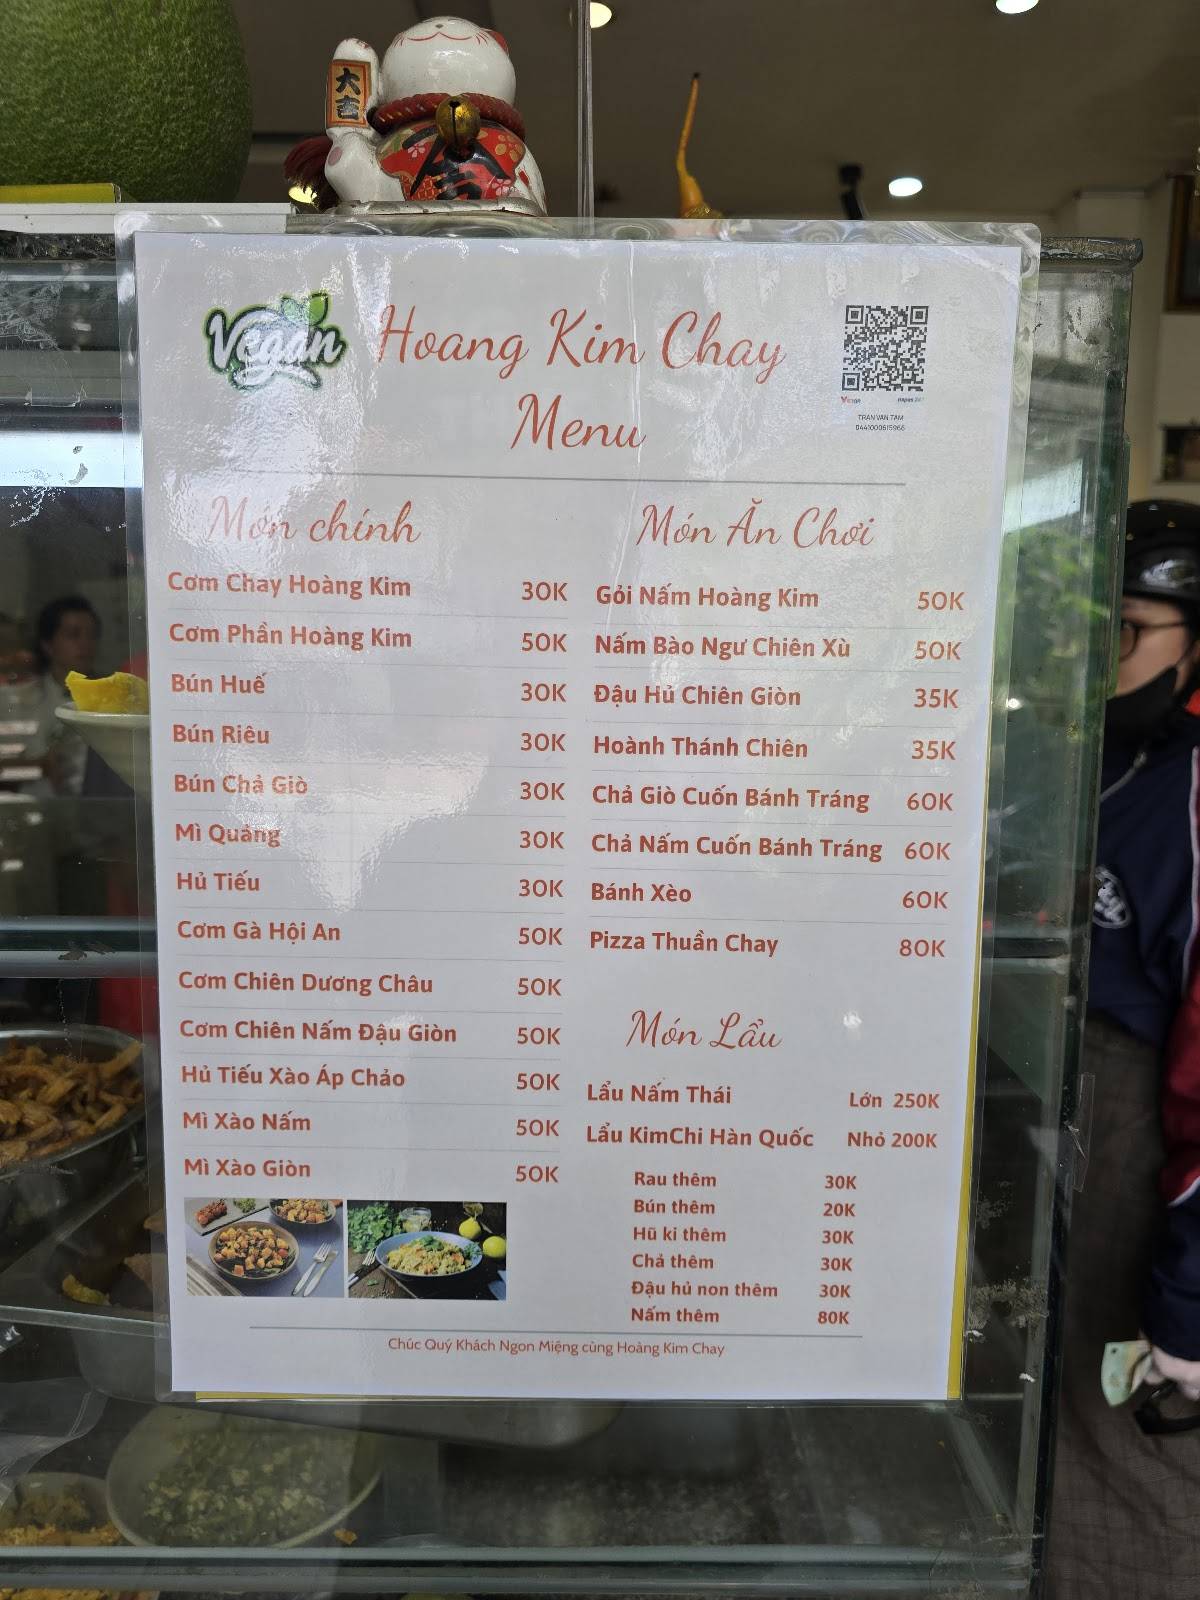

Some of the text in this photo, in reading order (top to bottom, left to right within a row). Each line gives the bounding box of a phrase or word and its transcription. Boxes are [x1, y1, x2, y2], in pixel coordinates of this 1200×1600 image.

[204, 306, 347, 390] Vegan
[376, 305, 786, 384] Hoang Kim Chay
[510, 393, 646, 450] Menu
[309, 499, 421, 544] chính
[636, 498, 875, 548] Món Ăn Chơi
[168, 572, 568, 602] Cơm Chay Hoàng Kim 30K
[596, 582, 964, 612] Gỏi Nấm Hoàng Kim 50K
[170, 622, 568, 652] Cơm Phần Hoàng Kim 50K
[596, 632, 962, 660] Nấm Bào Ngư Chiên Xù 50K
[172, 672, 566, 702] Bún Huế 30K
[594, 684, 958, 708] Đậu Hủ Chiên Giòn 35K
[172, 724, 566, 752] Bún Riêu 30K
[594, 736, 956, 760] Hoành Thánh Chiên 35K
[174, 774, 566, 800] Bún Chả Giò 30K
[592, 784, 954, 814] Chả Giò Cuốn Bánh Tráng 60K
[176, 822, 564, 850] Mì Quảng 30K
[592, 832, 950, 862] Chả Nấm Cuốn Bánh Tráng 60K
[176, 870, 564, 898] Hủ Tiếu 30K
[592, 882, 948, 910] Bánh Xèo 60K
[178, 920, 562, 946] Cơm Gà Hội An 50K
[590, 930, 946, 958] Pizza Thuần Chay 80K
[178, 970, 562, 996] Cơm Chiên Dương Châu 50K
[180, 1020, 560, 1046] Cơm Chiên Nấm Đậu Giòn 50K
[626, 1010, 783, 1050] Món Lẩu
[182, 1064, 560, 1090] Hủ Tiếu Xào Áp Chảo 50K
[588, 1080, 940, 1108] Lẩu Nấm Thái Lớn 250K
[184, 1110, 560, 1136] Mì Xào Nấm 50K
[586, 1122, 936, 1150] Lẩu KimChi Hàn Quốc Nhỏ 200K
[184, 1158, 558, 1182] Mì Xào Giòn 50K
[634, 1172, 856, 1190] Rau thêm 30K
[634, 1198, 856, 1218] Bún thêm 20K
[634, 1226, 854, 1244] Hũ ki thêm 30K
[632, 1254, 852, 1272] Chả thêm 30K
[630, 1280, 850, 1298] Đậu hủ non thêm 30K
[632, 1306, 850, 1324] Nấm thêm 80K
[388, 1338, 421, 1350] Chúc
[425, 1339, 452, 1353] Quý
[456, 1339, 495, 1351] Khách
[500, 1339, 534, 1354] Ngon
[539, 1340, 578, 1356] Miệng
[664, 1342, 688, 1354] Kim
[692, 1342, 725, 1357] Chay
